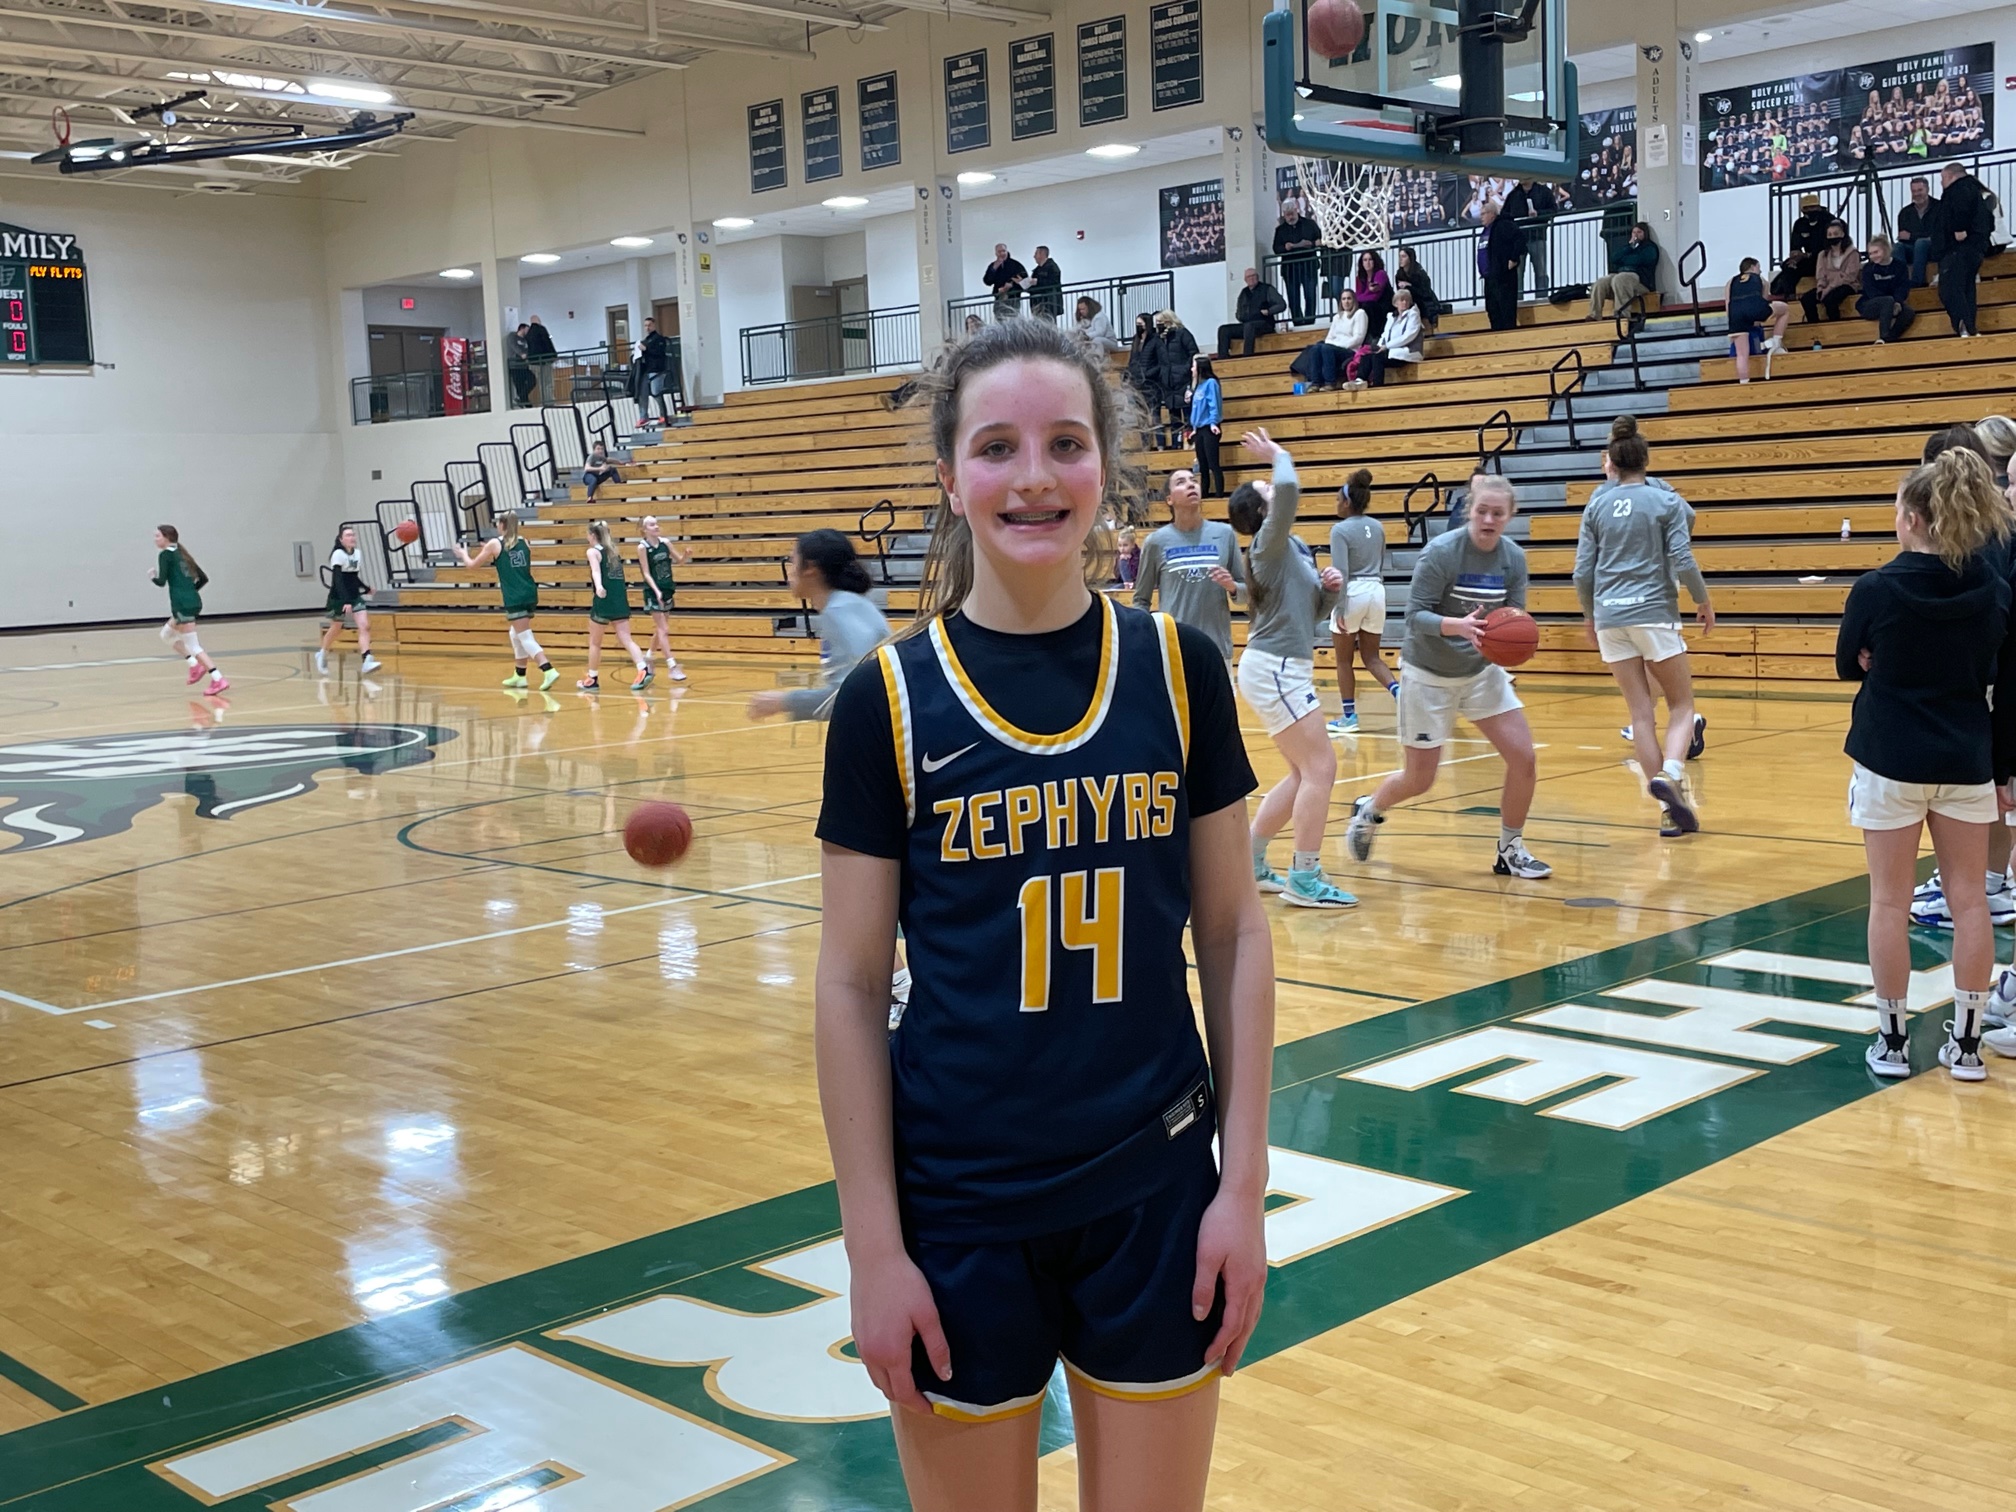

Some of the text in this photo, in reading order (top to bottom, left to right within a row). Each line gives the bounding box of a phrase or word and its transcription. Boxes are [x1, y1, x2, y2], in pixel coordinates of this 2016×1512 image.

[1896, 54, 1954, 73] HOLY FAMILY
[1882, 64, 1969, 88] GIRLS SOCCER 2021
[1652, 67, 1660, 123] ADULTS
[1751, 81, 1803, 98] HOLY FAMILY
[1751, 93, 1804, 111] SOCCER 2021
[0, 232, 75, 260] MILY
[29, 265, 83, 279] PLY FL PTS
[2, 322, 28, 330] FOULS
[1612, 498, 1632, 518] 23
[1364, 525, 1372, 539] 3
[509, 550, 527, 568] 21
[933, 771, 1179, 862] ZEPHYRS
[1016, 867, 1125, 1012] 14
[1197, 1094, 1205, 1108] S
